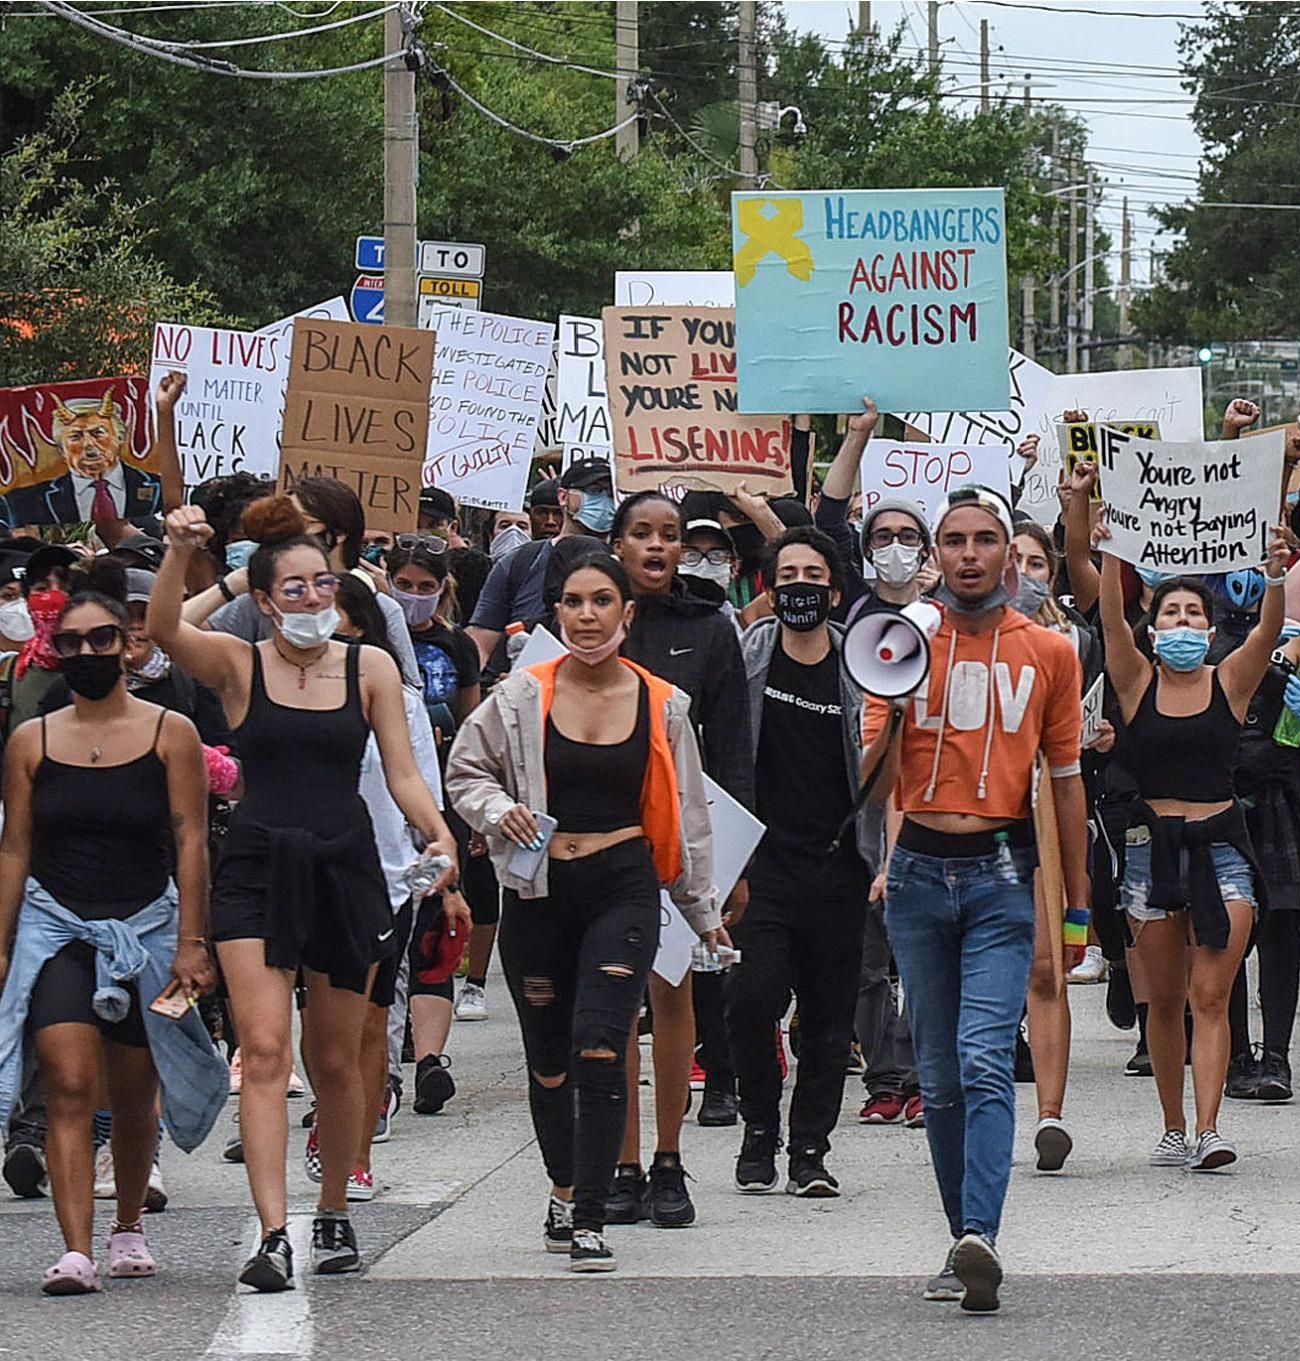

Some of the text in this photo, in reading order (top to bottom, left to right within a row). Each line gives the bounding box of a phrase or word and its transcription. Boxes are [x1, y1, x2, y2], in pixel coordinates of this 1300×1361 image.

[825, 197, 1000, 244] HEADBANGERS
[437, 250, 468, 268] TO
[850, 249, 975, 294] AGAINST
[431, 281, 469, 295] TOLL
[434, 311, 475, 335] THE
[479, 316, 549, 346] POLICE
[622, 316, 671, 339] IF
[682, 318, 737, 349] YOU'
[839, 302, 976, 346] RACISM
[154, 326, 279, 372] NO LIVES
[300, 330, 423, 384] BLACK
[434, 343, 546, 377] NVESTIGATED
[620, 352, 737, 377] NOT LIV
[203, 379, 264, 403] MATTER
[432, 369, 538, 402] HE POLICE
[620, 384, 702, 417] YOURE
[181, 402, 225, 422] UNTIL
[302, 400, 415, 452] LIVES
[430, 395, 535, 427] ND FOUND THE
[178, 420, 246, 457] LACK
[617, 420, 792, 470] LISENING!
[1100, 427, 1130, 471] IF
[1204, 454, 1241, 483] not
[181, 453, 244, 479] IVES
[424, 443, 512, 485] OT GUILTY
[883, 450, 971, 493] STOP
[283, 461, 412, 513] MTER
[1139, 487, 1201, 524] Angry
[1150, 519, 1187, 537] not
[1189, 507, 1256, 541] paying
